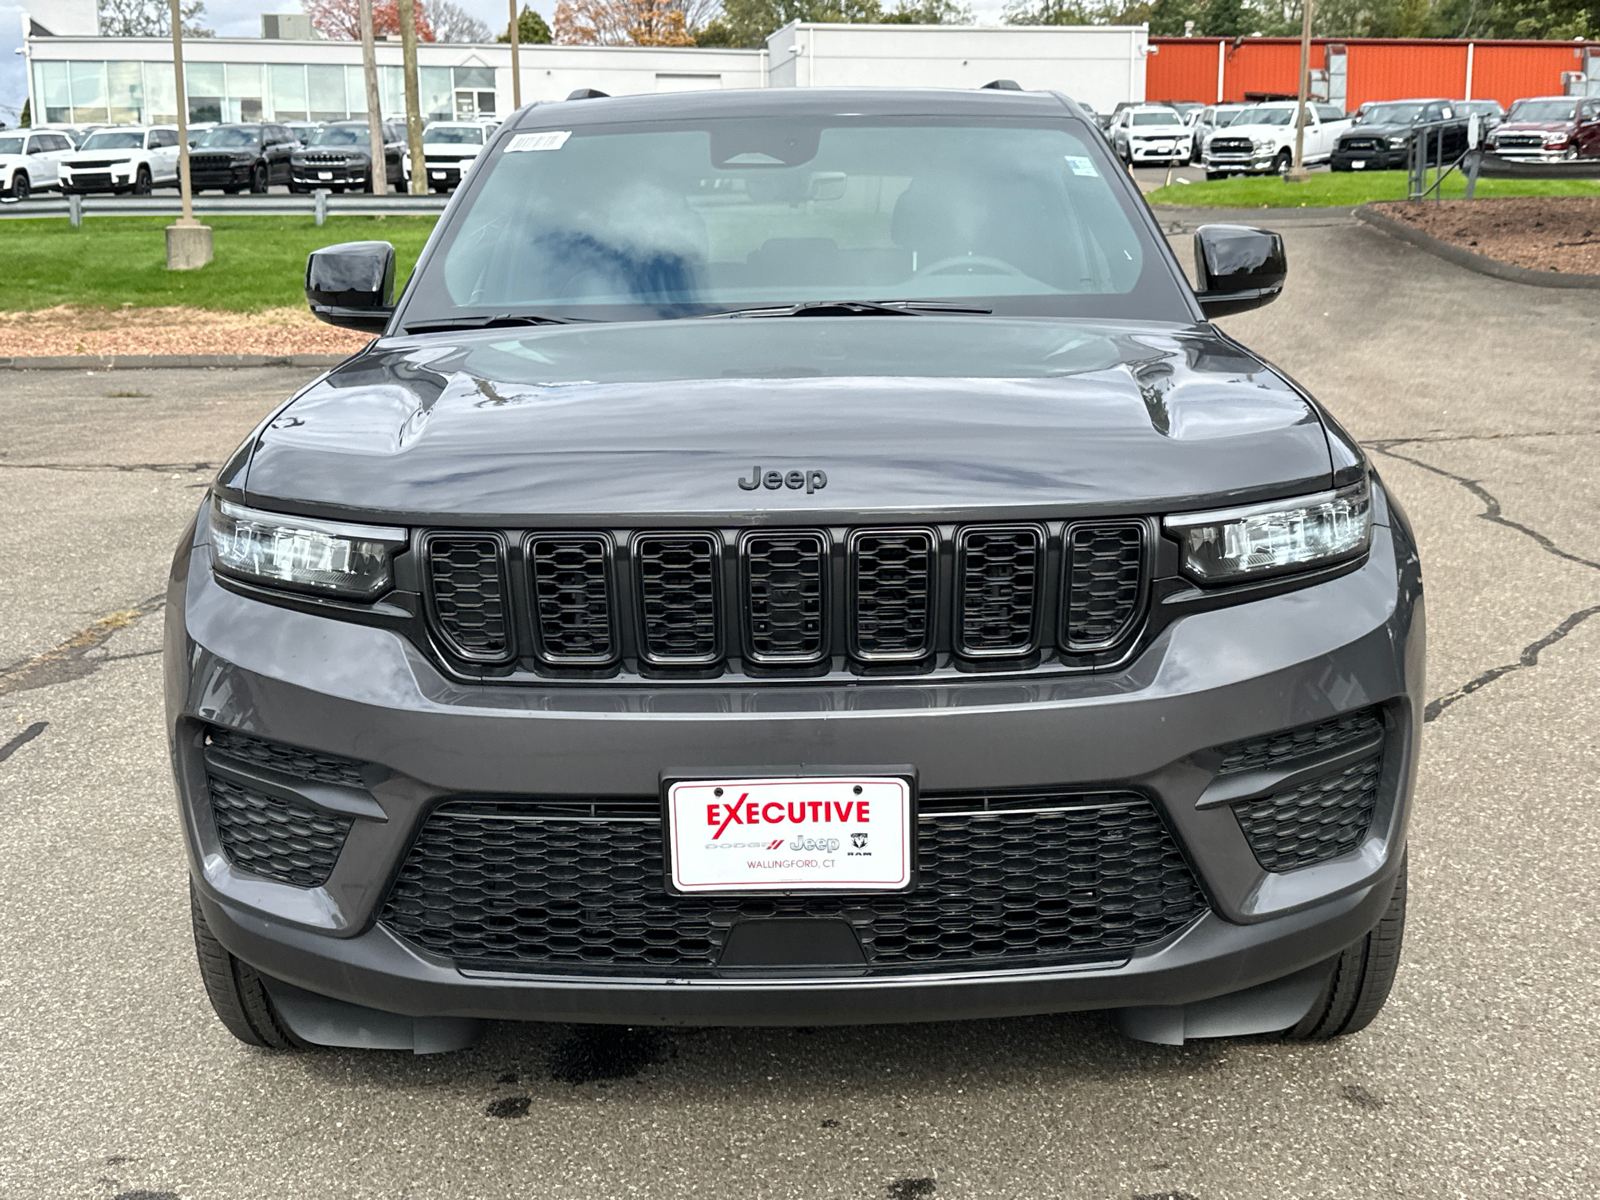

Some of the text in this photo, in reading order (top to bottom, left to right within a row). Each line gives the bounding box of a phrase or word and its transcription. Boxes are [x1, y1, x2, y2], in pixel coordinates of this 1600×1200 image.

[738, 465, 828, 494] Jeep
[706, 793, 870, 840] EXECUTIVE
[789, 835, 841, 853] Jeep
[746, 859, 836, 869] WALLINGFORD, CT
